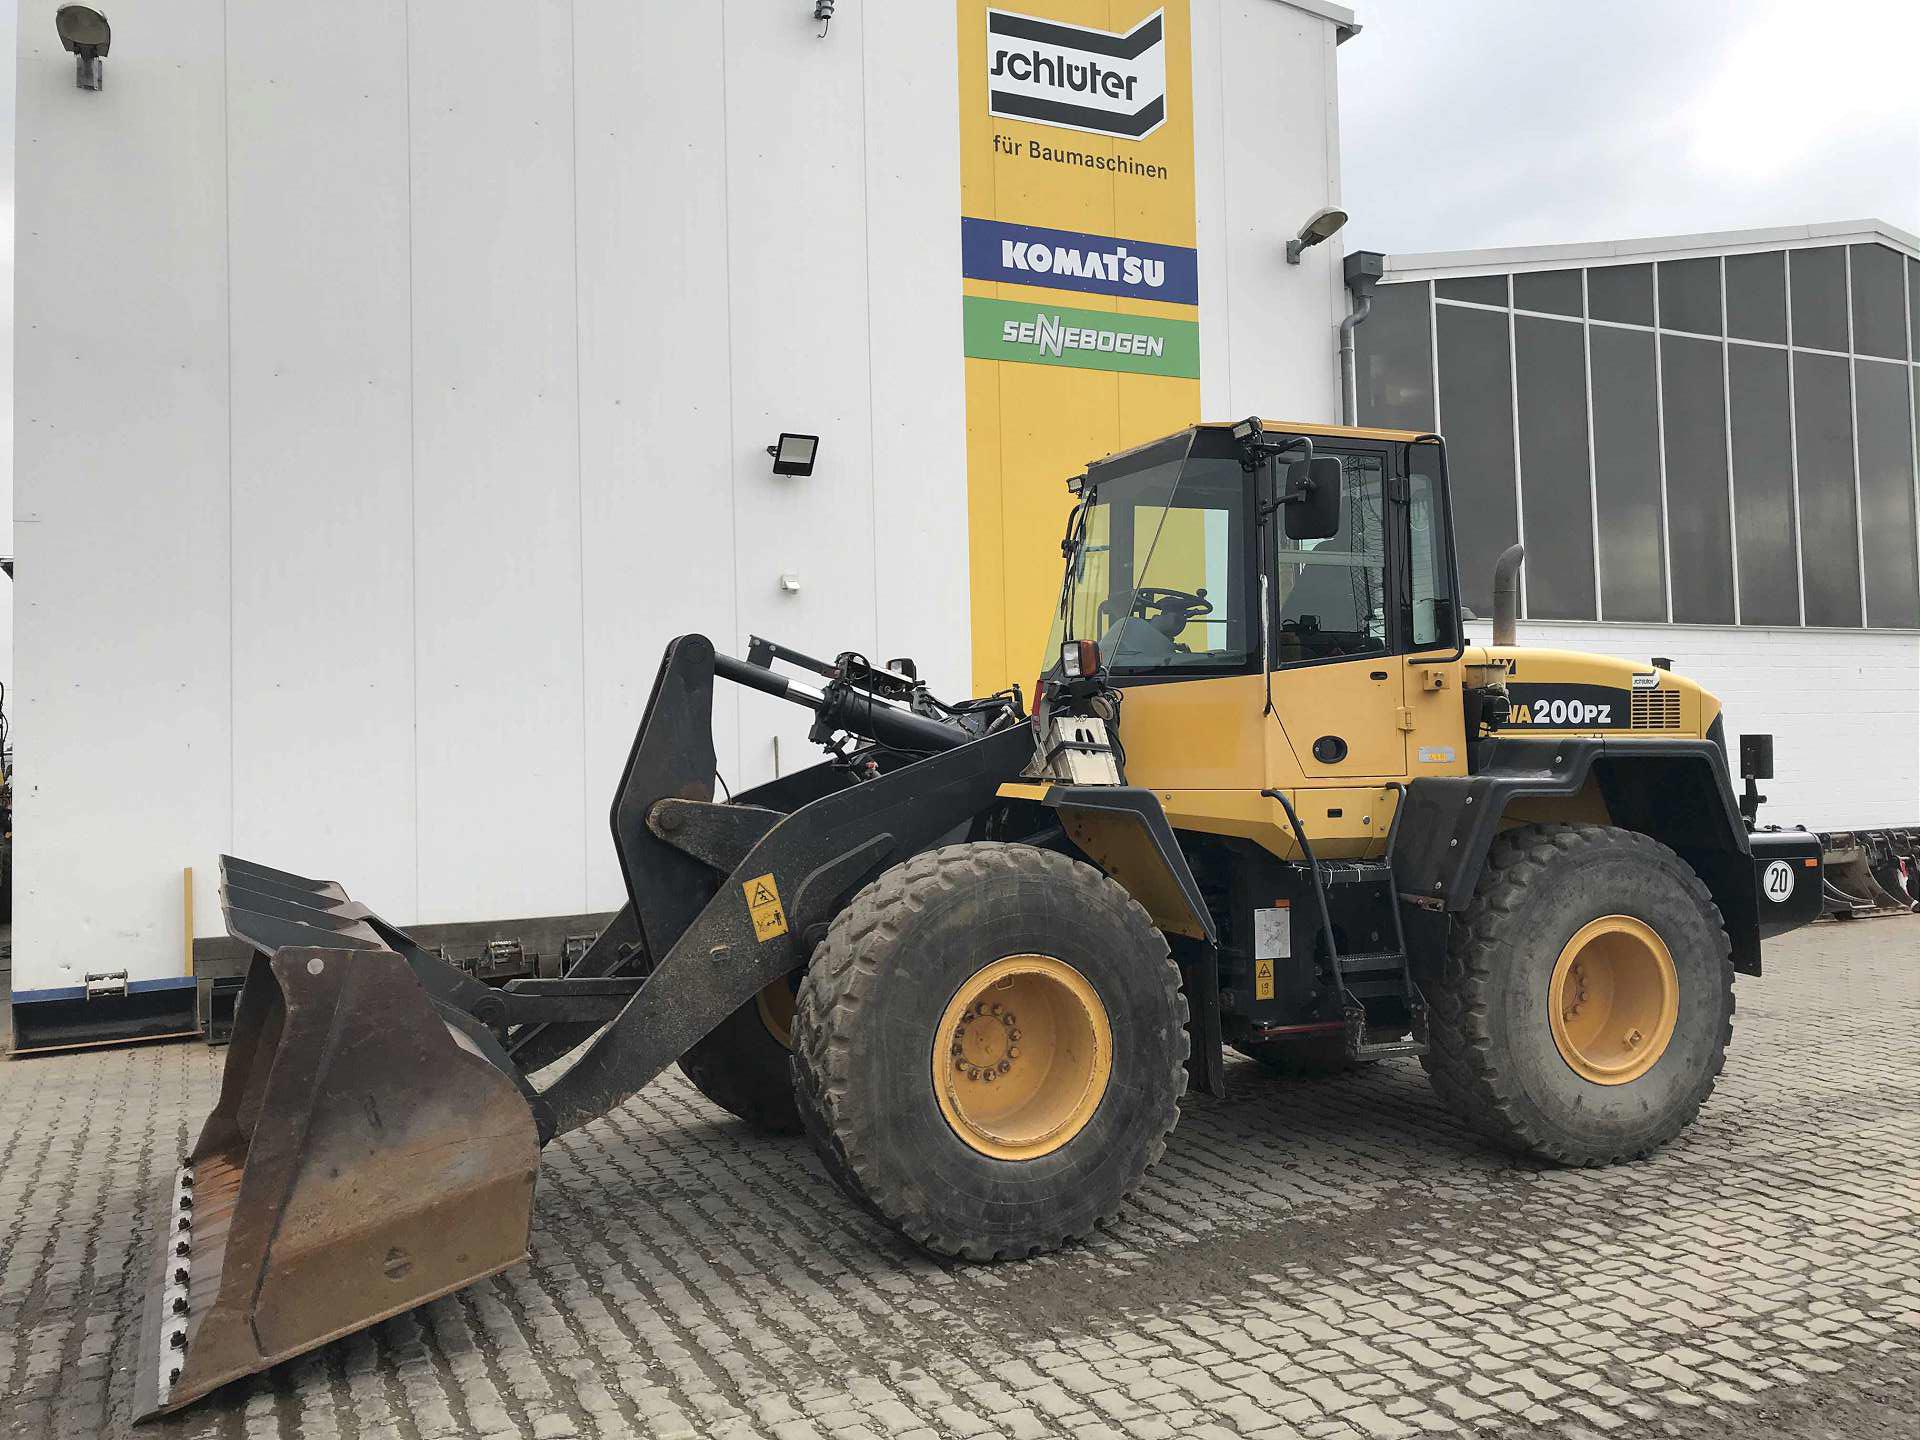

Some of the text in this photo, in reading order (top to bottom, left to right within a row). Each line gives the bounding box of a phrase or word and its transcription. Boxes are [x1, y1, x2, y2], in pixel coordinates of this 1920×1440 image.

[993, 135, 1168, 180] für Baumaschinen
[1002, 239, 1165, 287] KOMATSU
[1002, 313, 1164, 357] SENNEBOGEN
[1770, 867, 1788, 893] 20
